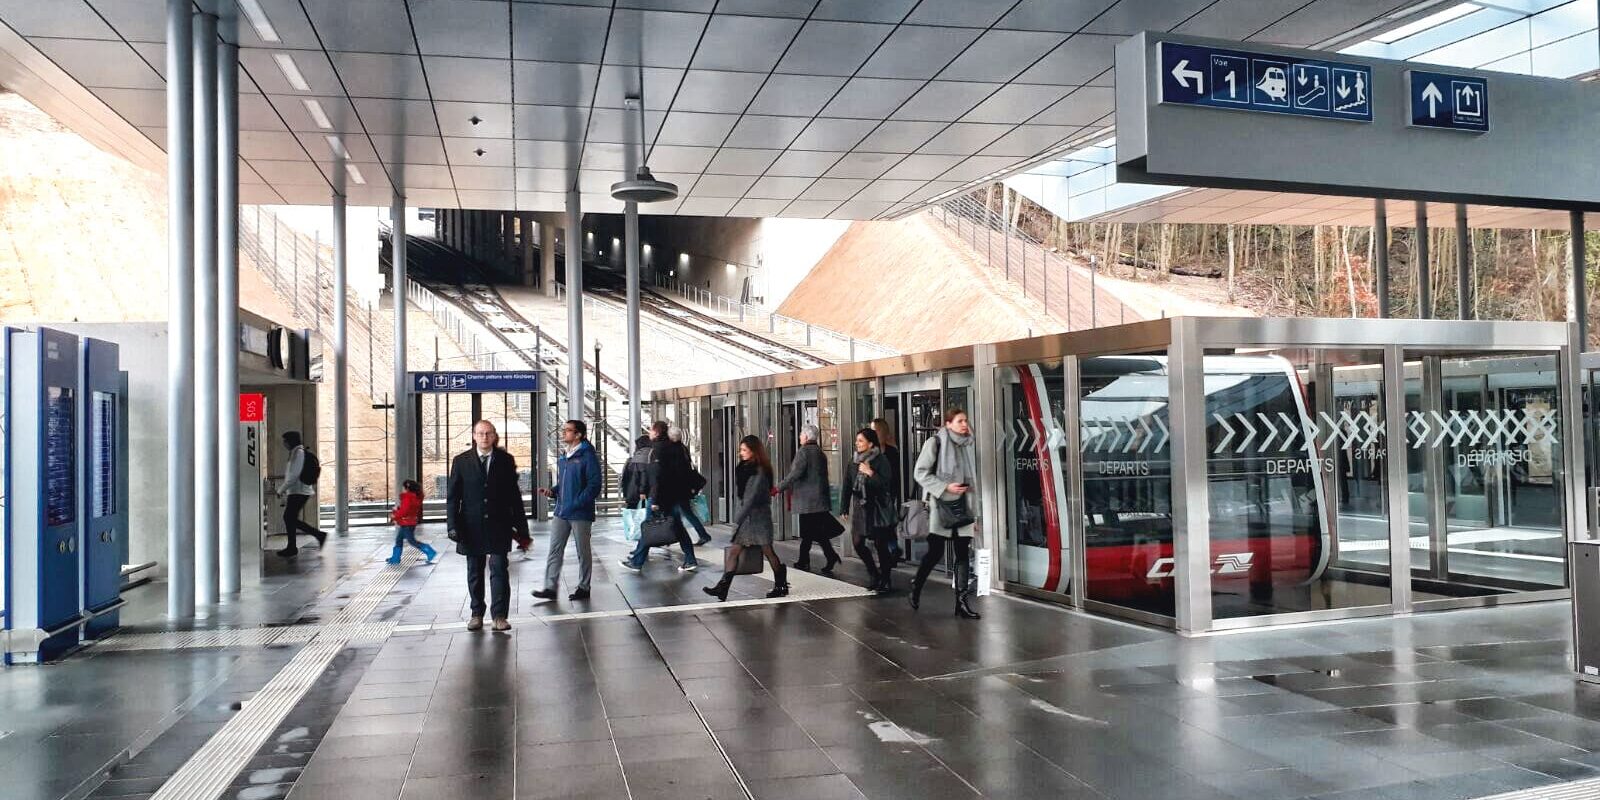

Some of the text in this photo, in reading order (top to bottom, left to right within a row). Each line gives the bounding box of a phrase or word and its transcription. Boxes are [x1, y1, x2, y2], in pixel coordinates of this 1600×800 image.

[1224, 70, 1236, 98] 1
[246, 400, 257, 418] SOS
[1099, 460, 1150, 476] DEPARTS
[1266, 458, 1335, 475] DEPARTS
